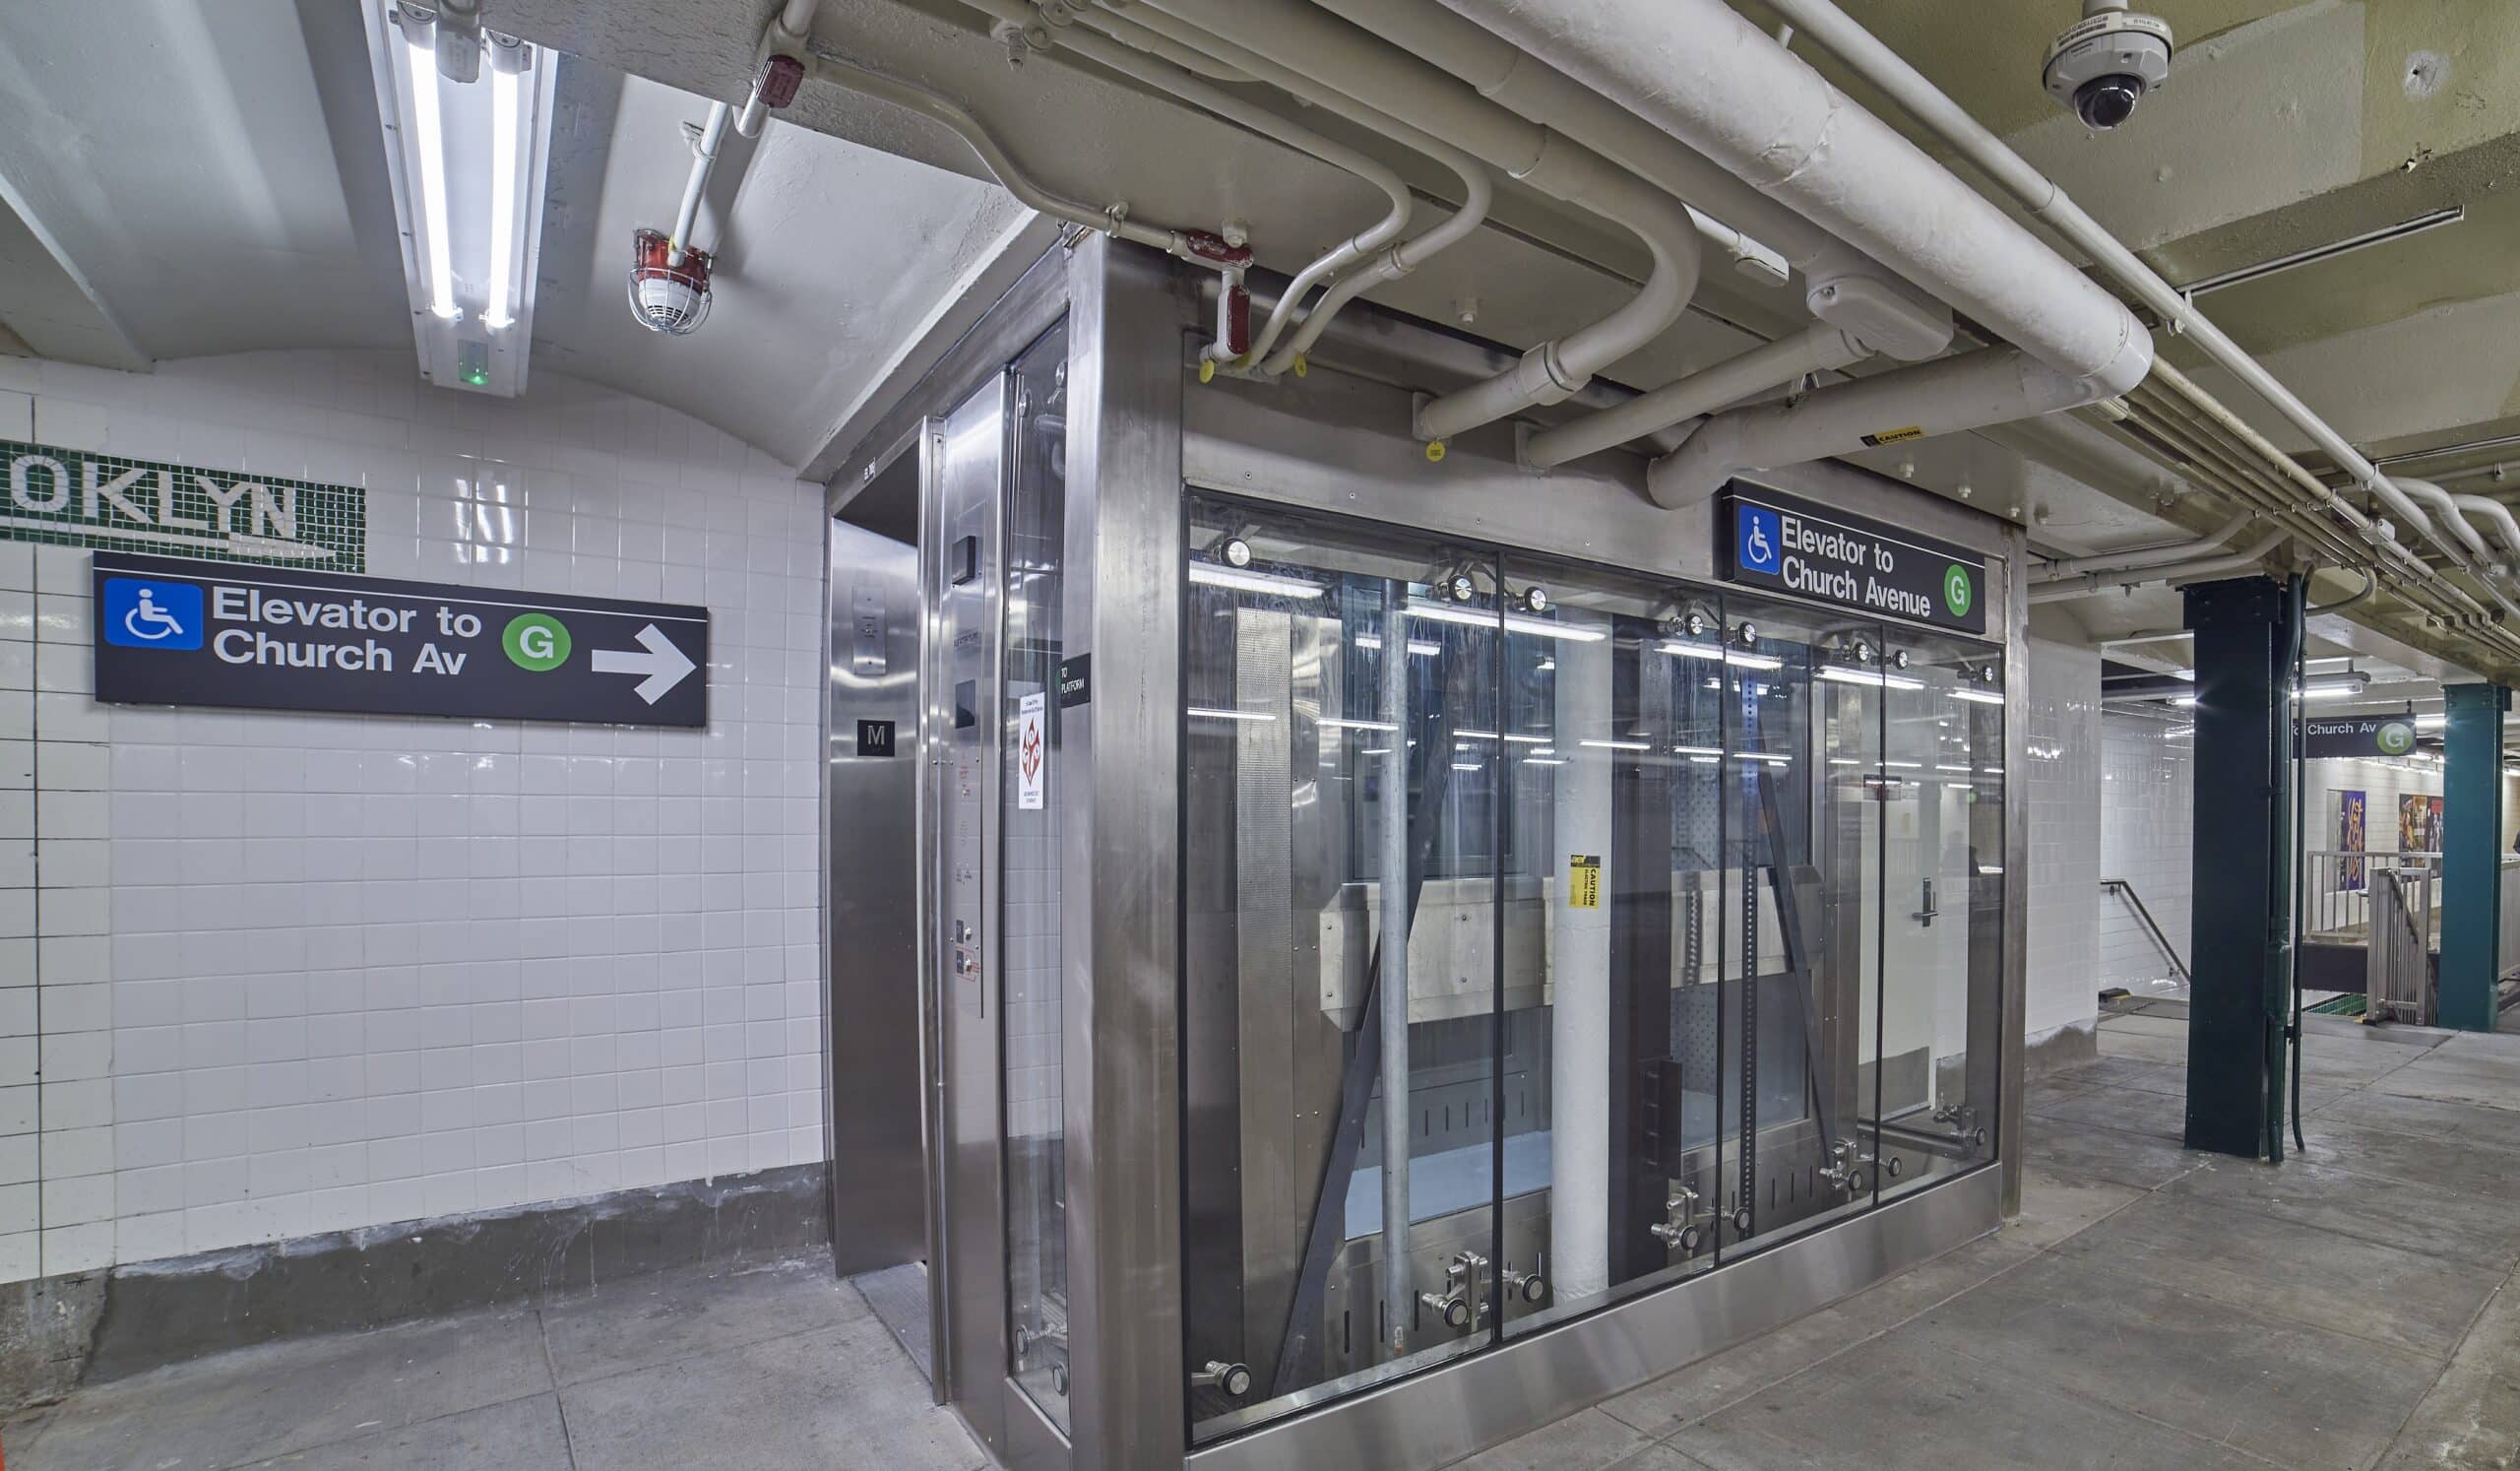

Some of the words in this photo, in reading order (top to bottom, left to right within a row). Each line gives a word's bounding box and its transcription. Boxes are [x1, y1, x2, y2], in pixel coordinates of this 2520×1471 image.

[10, 455, 295, 538] OKLYN
[1782, 515, 1866, 566] Elevator
[1874, 543, 1894, 573] to
[1783, 555, 1858, 601] Church
[1865, 576, 1931, 617] Avenue
[1950, 575, 1965, 605] G
[212, 586, 417, 633] Elevator
[436, 607, 481, 638] to
[213, 629, 393, 672] Church
[412, 643, 467, 675] Av
[519, 625, 554, 659] G
[1061, 667, 1067, 677] TO
[1061, 677, 1085, 694] PLATFORM
[867, 725, 885, 745] M
[2307, 723, 2354, 735] Church
[2359, 722, 2376, 734] Av
[2385, 732, 2404, 747] G
